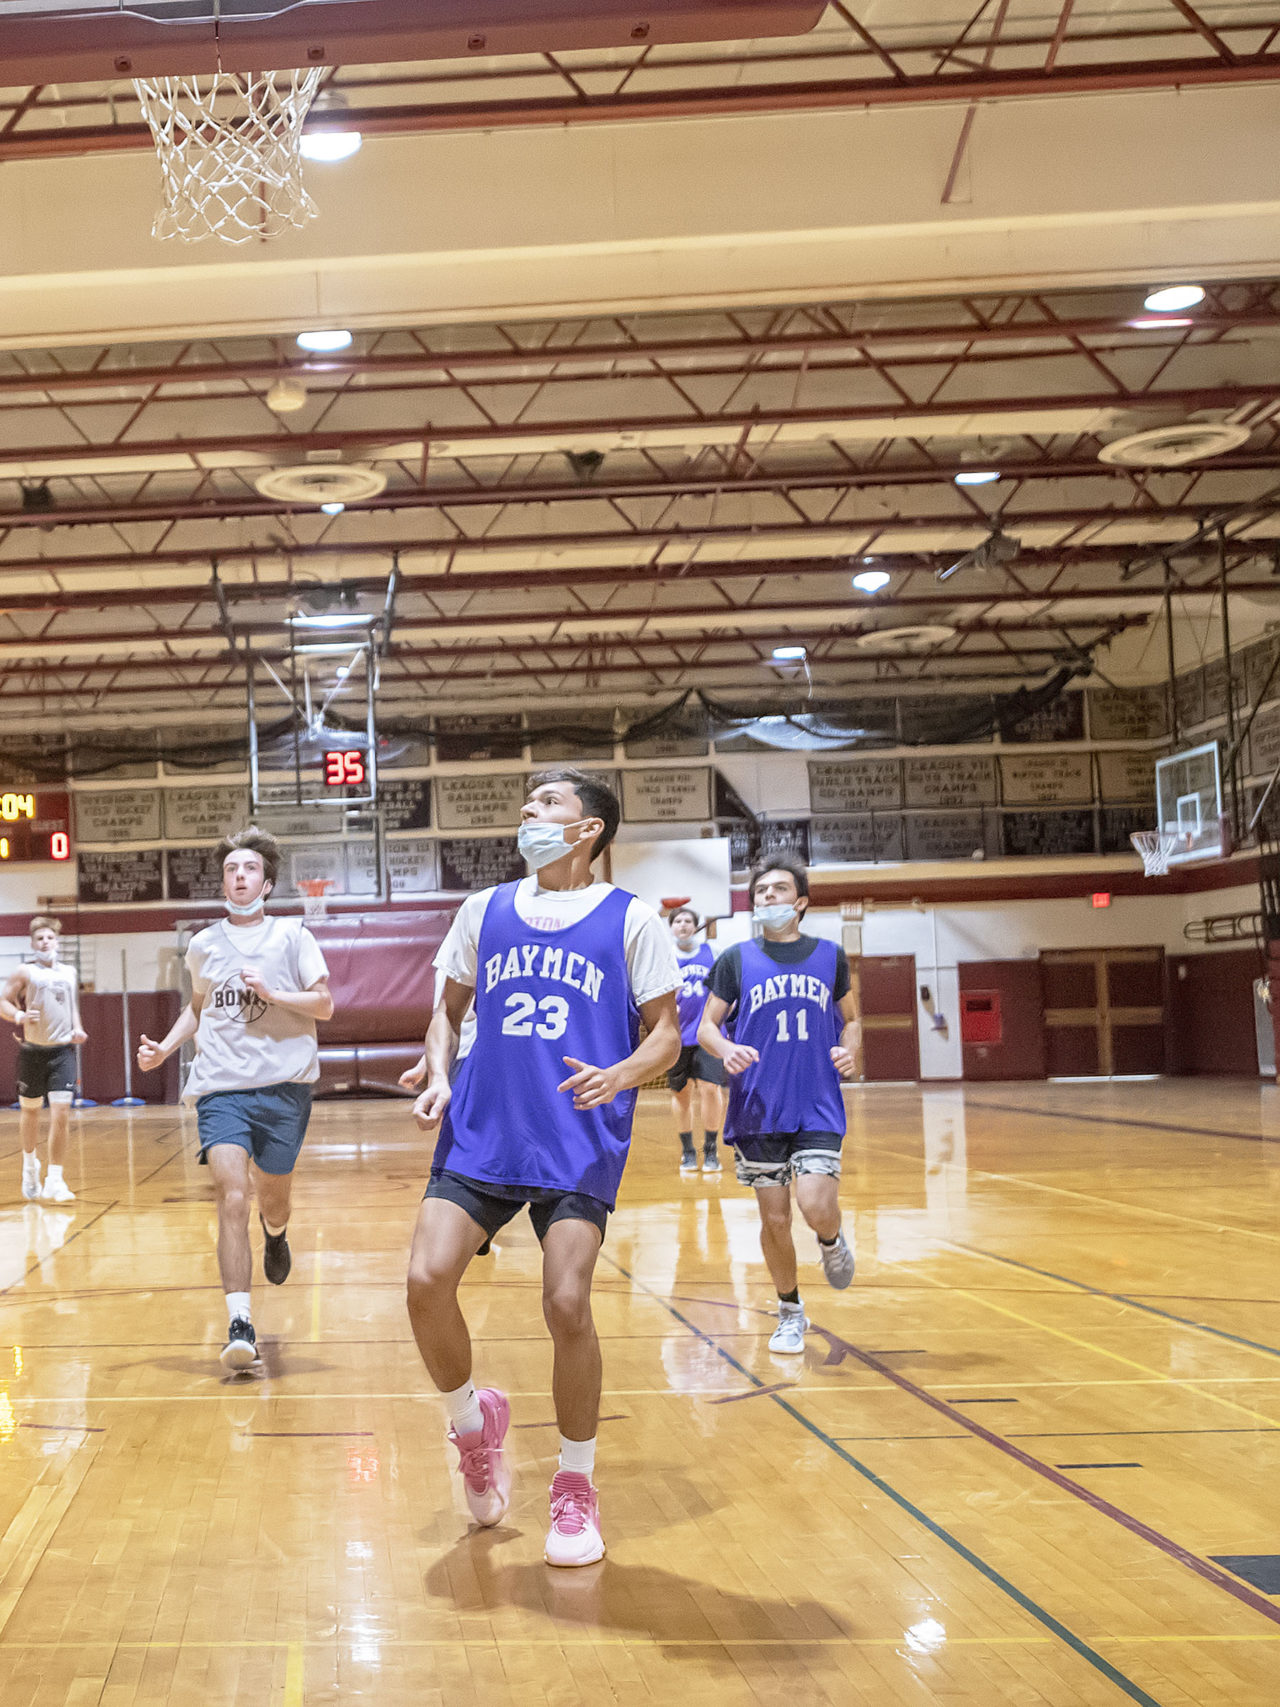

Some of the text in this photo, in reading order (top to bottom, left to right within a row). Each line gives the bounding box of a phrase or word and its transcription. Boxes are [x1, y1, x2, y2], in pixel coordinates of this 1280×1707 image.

[325, 750, 366, 786] 35
[816, 765, 868, 775] LEAGUE
[908, 760, 962, 771] LEAGUE
[441, 779, 494, 792] LEAGUE
[924, 783, 978, 794] CHAMPS
[167, 789, 220, 802] LEAGUE
[455, 802, 509, 814] CHAMPS
[92, 815, 144, 828] CHAMPS
[181, 813, 233, 825] CHAMPS
[50, 831, 69, 860] 0
[485, 945, 605, 1003] BAYMEN
[682, 980, 705, 998] 34
[749, 973, 831, 1014] BAYMEN
[502, 992, 569, 1040] 23
[776, 1008, 809, 1042] 11
